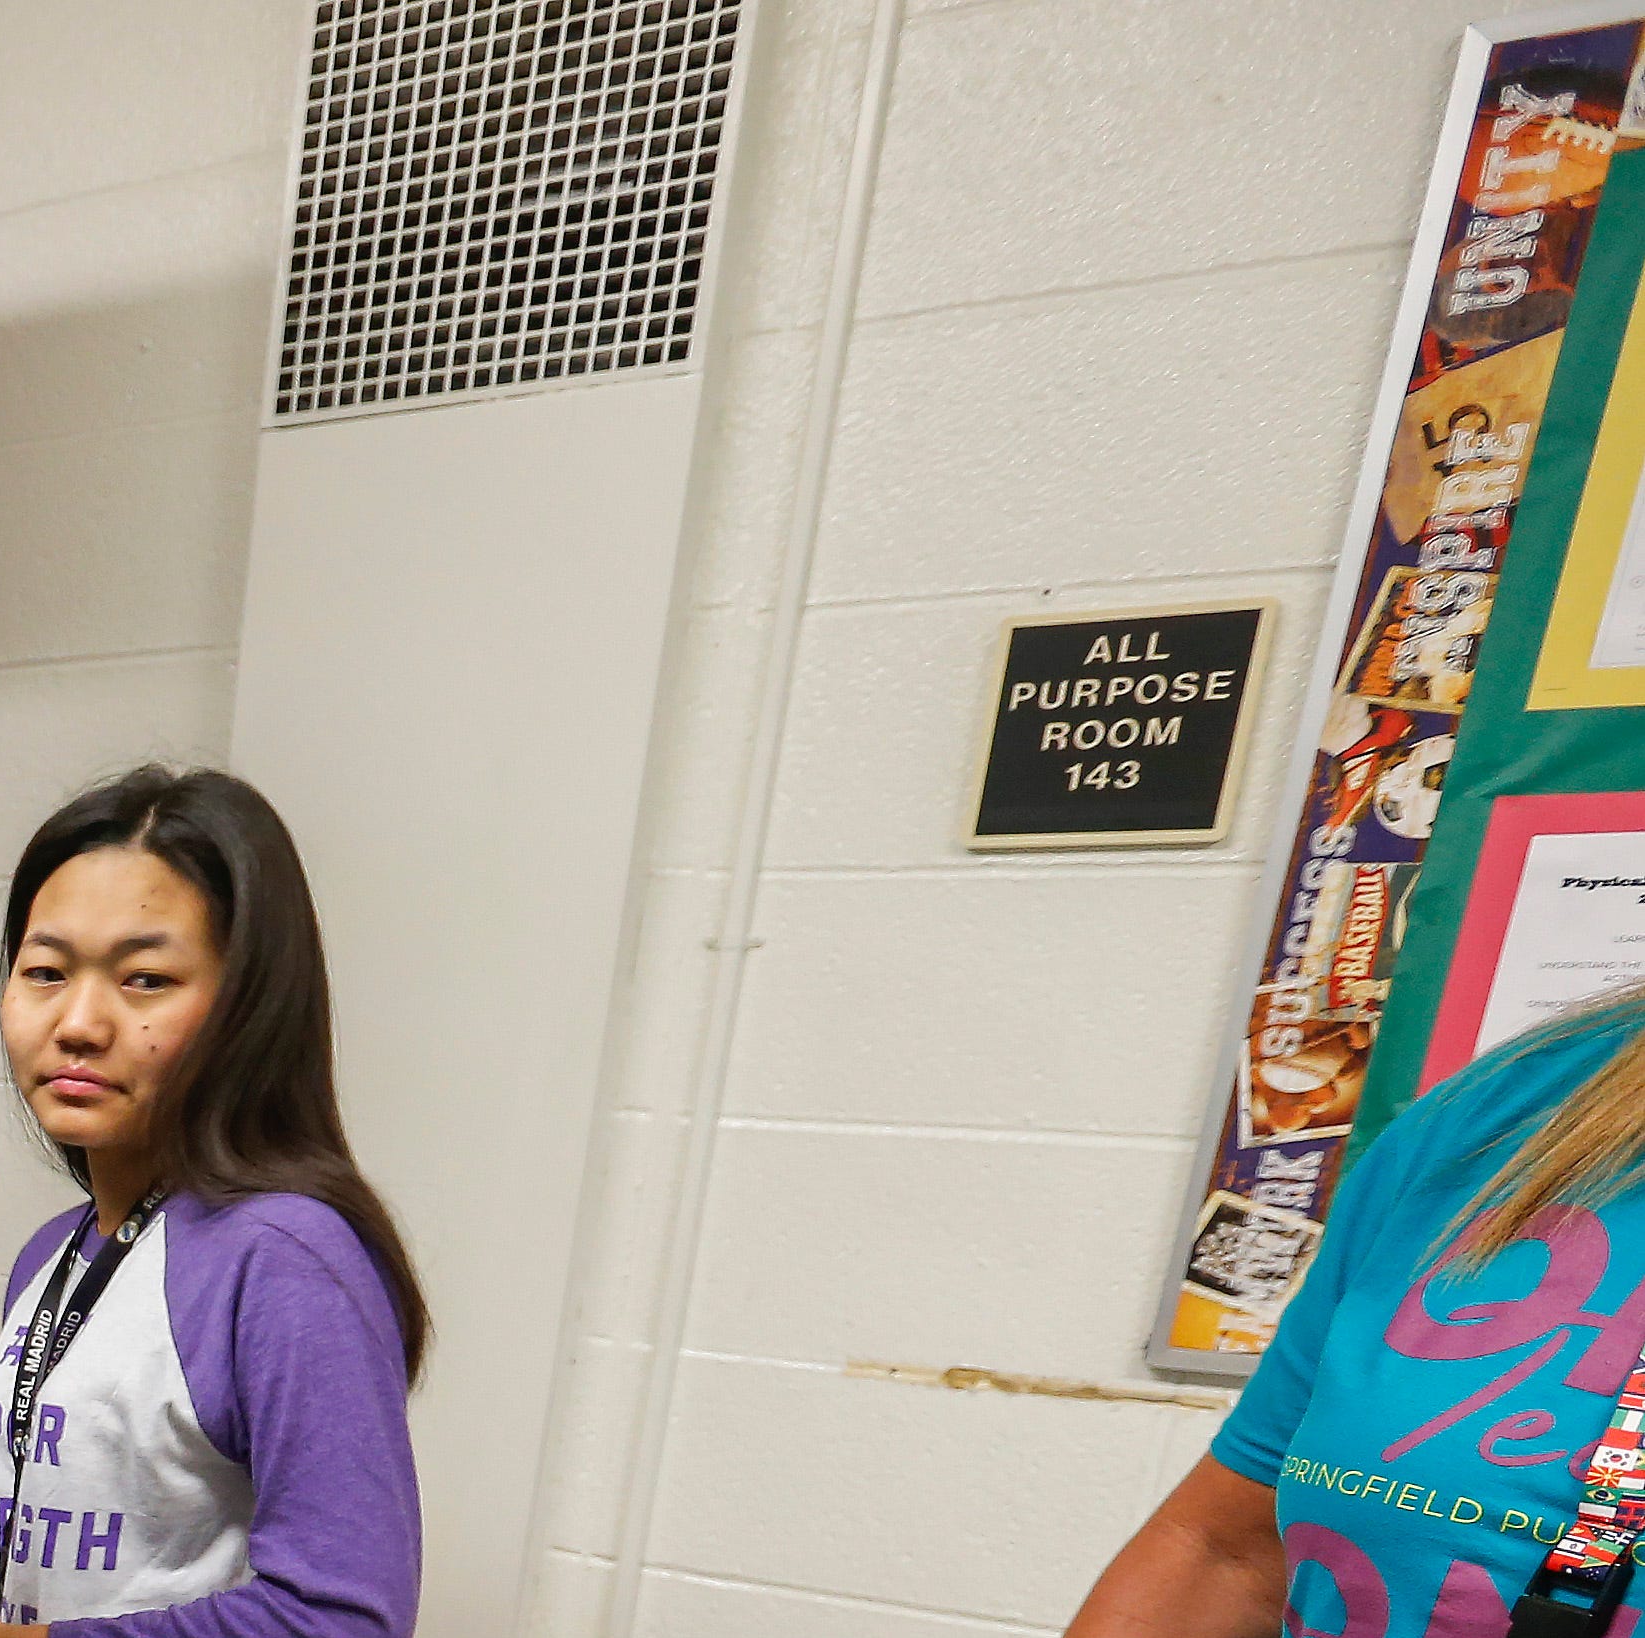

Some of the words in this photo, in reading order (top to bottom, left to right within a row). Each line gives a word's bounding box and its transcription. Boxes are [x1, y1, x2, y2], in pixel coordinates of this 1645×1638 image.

[1448, 83, 1577, 317] UNITY
[1083, 631, 1170, 665] ALL
[1008, 670, 1236, 711] PURPOSE
[1040, 716, 1183, 751] ROOM
[1064, 760, 1141, 791] 143
[1260, 823, 1358, 1058] SUCCESS
[1333, 867, 1386, 980] BASEBALL
[23, 1308, 53, 1374] MADRID
[14, 1378, 37, 1421] REAL
